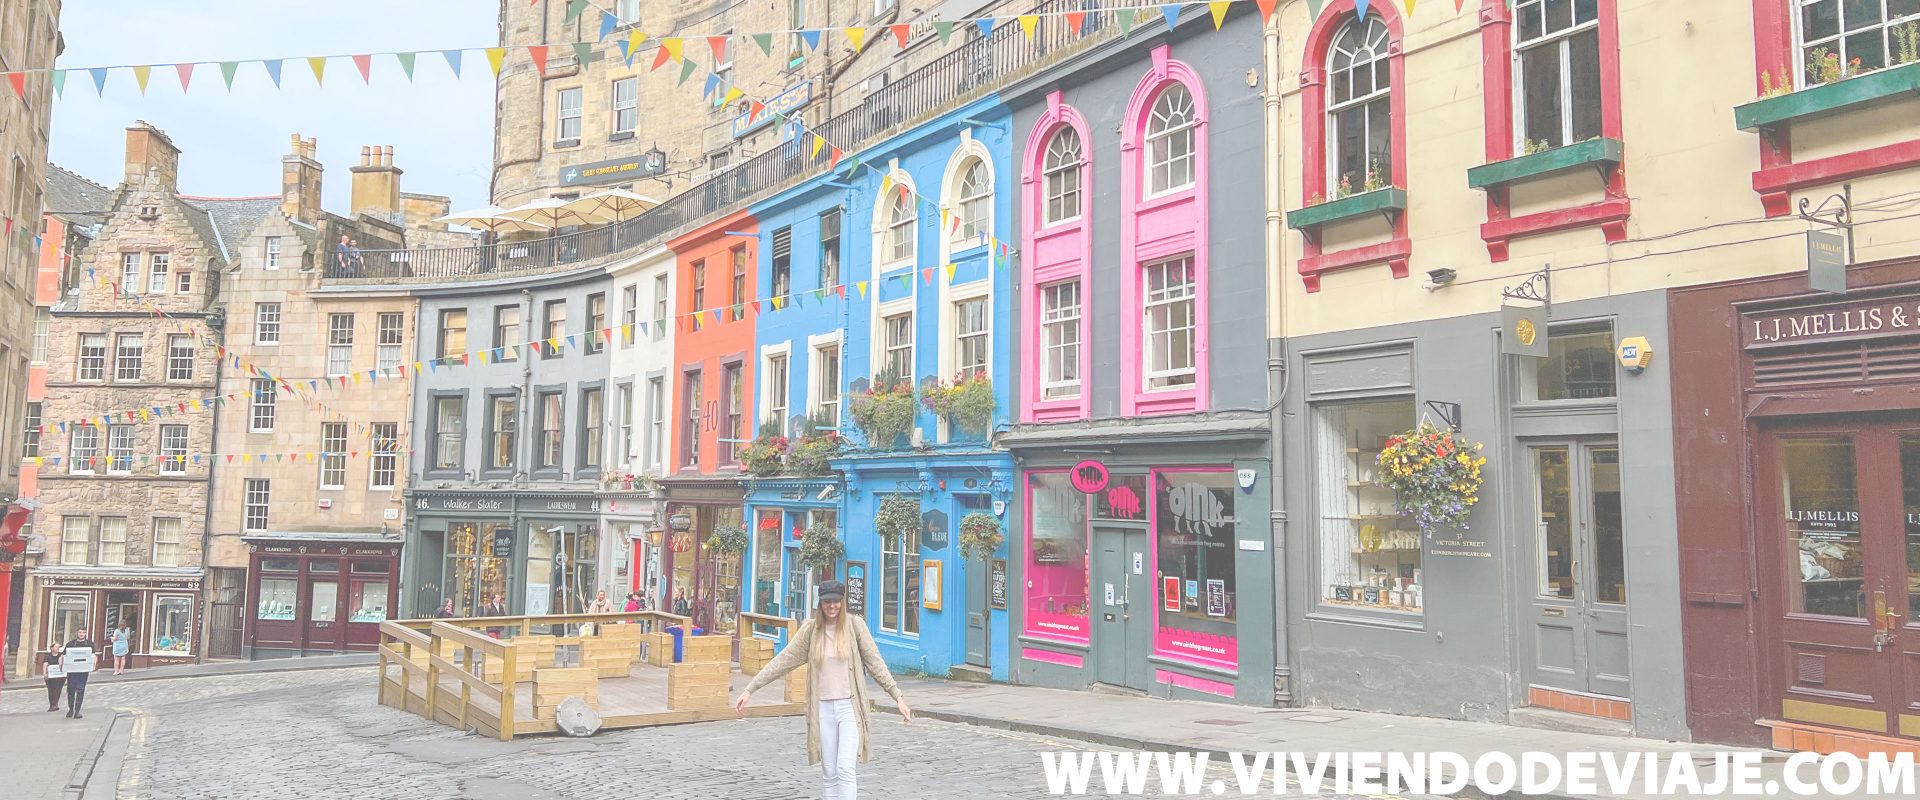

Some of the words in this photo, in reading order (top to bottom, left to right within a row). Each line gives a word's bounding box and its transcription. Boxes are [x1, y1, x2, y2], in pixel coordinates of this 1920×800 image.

[1754, 307, 1883, 342] I.J.MELLIS
[1891, 305, 1910, 328] &
[1623, 348, 1636, 357] ADT
[703, 399, 718, 432] 40
[443, 498, 473, 509] Walker
[477, 499, 502, 510] Slater
[1789, 510, 1859, 522] I.J.MELLIS
[43, 578, 55, 586] 89
[187, 581, 200, 589] 89
